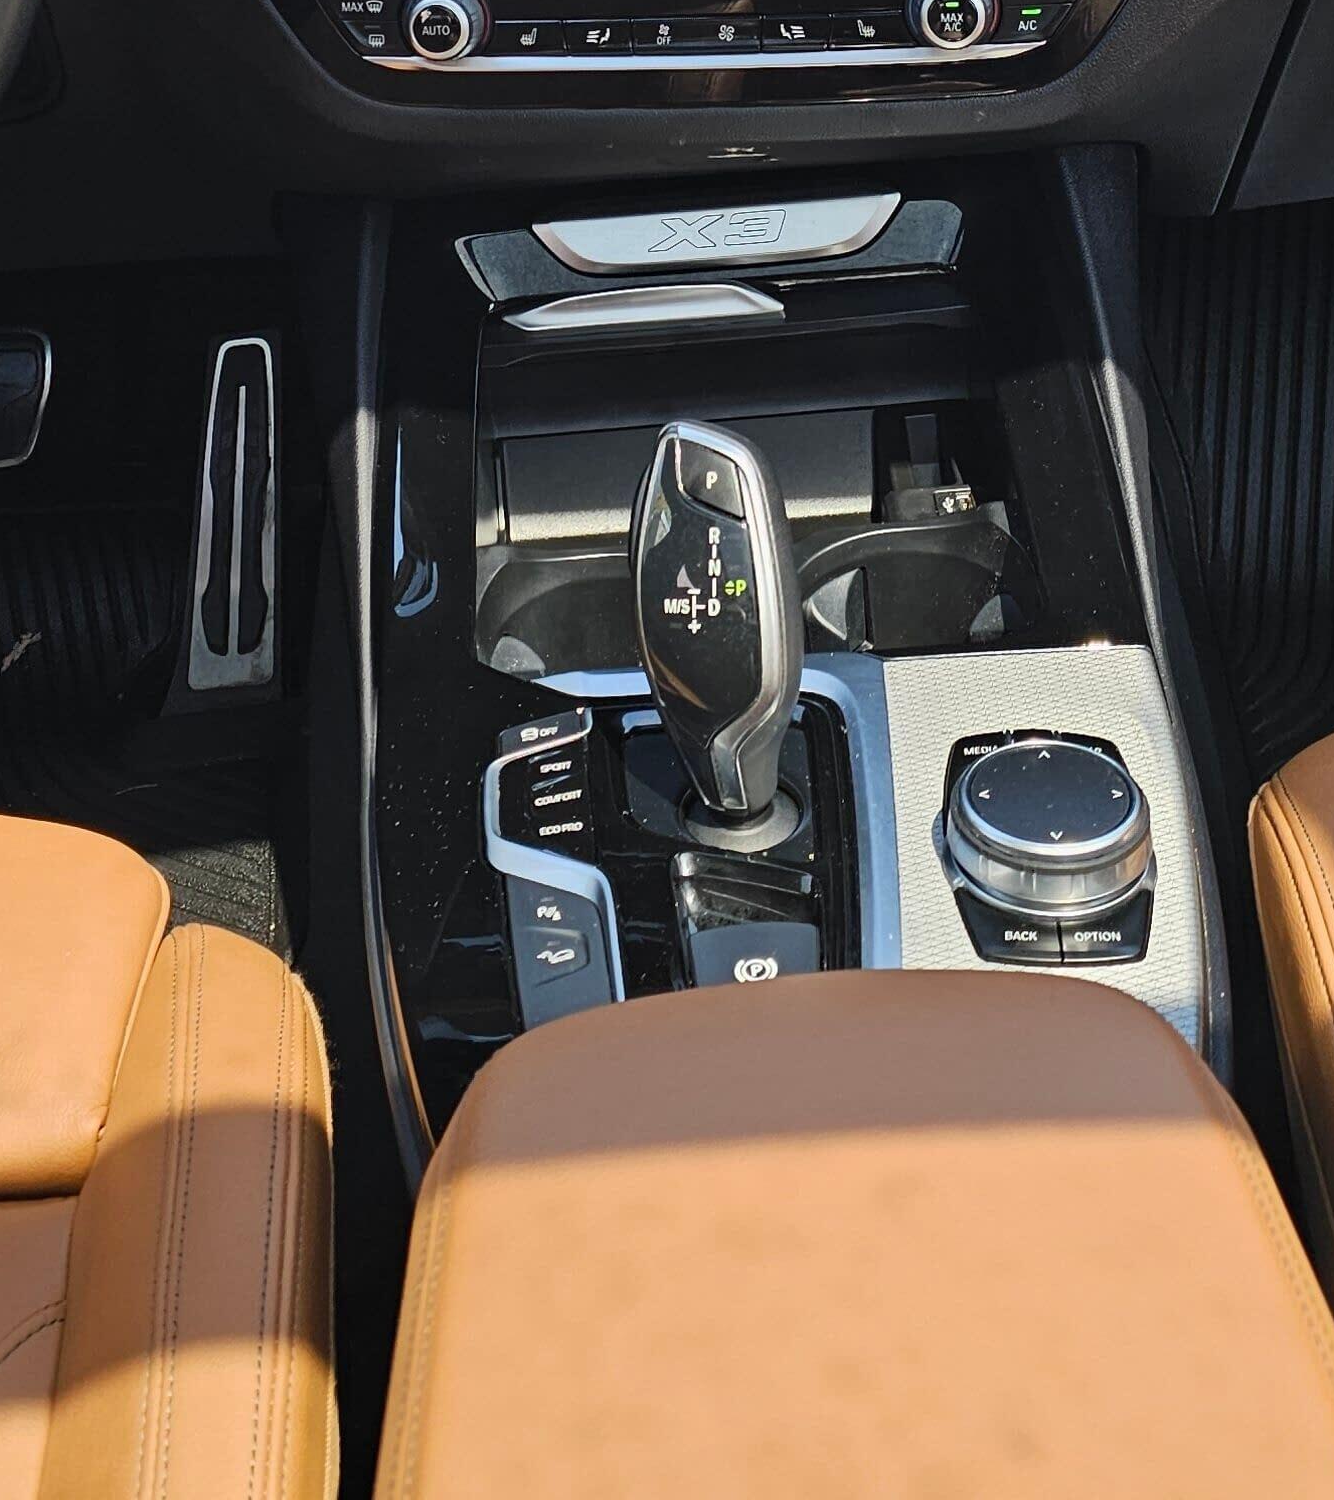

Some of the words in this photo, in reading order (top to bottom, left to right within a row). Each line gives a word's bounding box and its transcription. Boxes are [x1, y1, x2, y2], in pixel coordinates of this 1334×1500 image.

[341, 2, 364, 13] MAX
[940, 12, 964, 24] MAX
[421, 25, 451, 36] AUTO
[943, 21, 962, 33] A/C
[1017, 19, 1038, 32] A/C
[656, 35, 672, 45] OFF
[648, 209, 786, 252] X3
[706, 471, 718, 489] P
[708, 526, 721, 544] R
[708, 559, 721, 577] N
[735, 579, 747, 597] P
[663, 598, 690, 615] M/S
[707, 598, 721, 616] D
[539, 726, 559, 737] OFF
[539, 761, 572, 773] SPORT
[534, 789, 582, 807] COMFORT
[539, 825, 561, 837] ECO
[561, 821, 583, 833] PRO
[1004, 931, 1038, 941] BACK
[1074, 931, 1121, 942] OPTION
